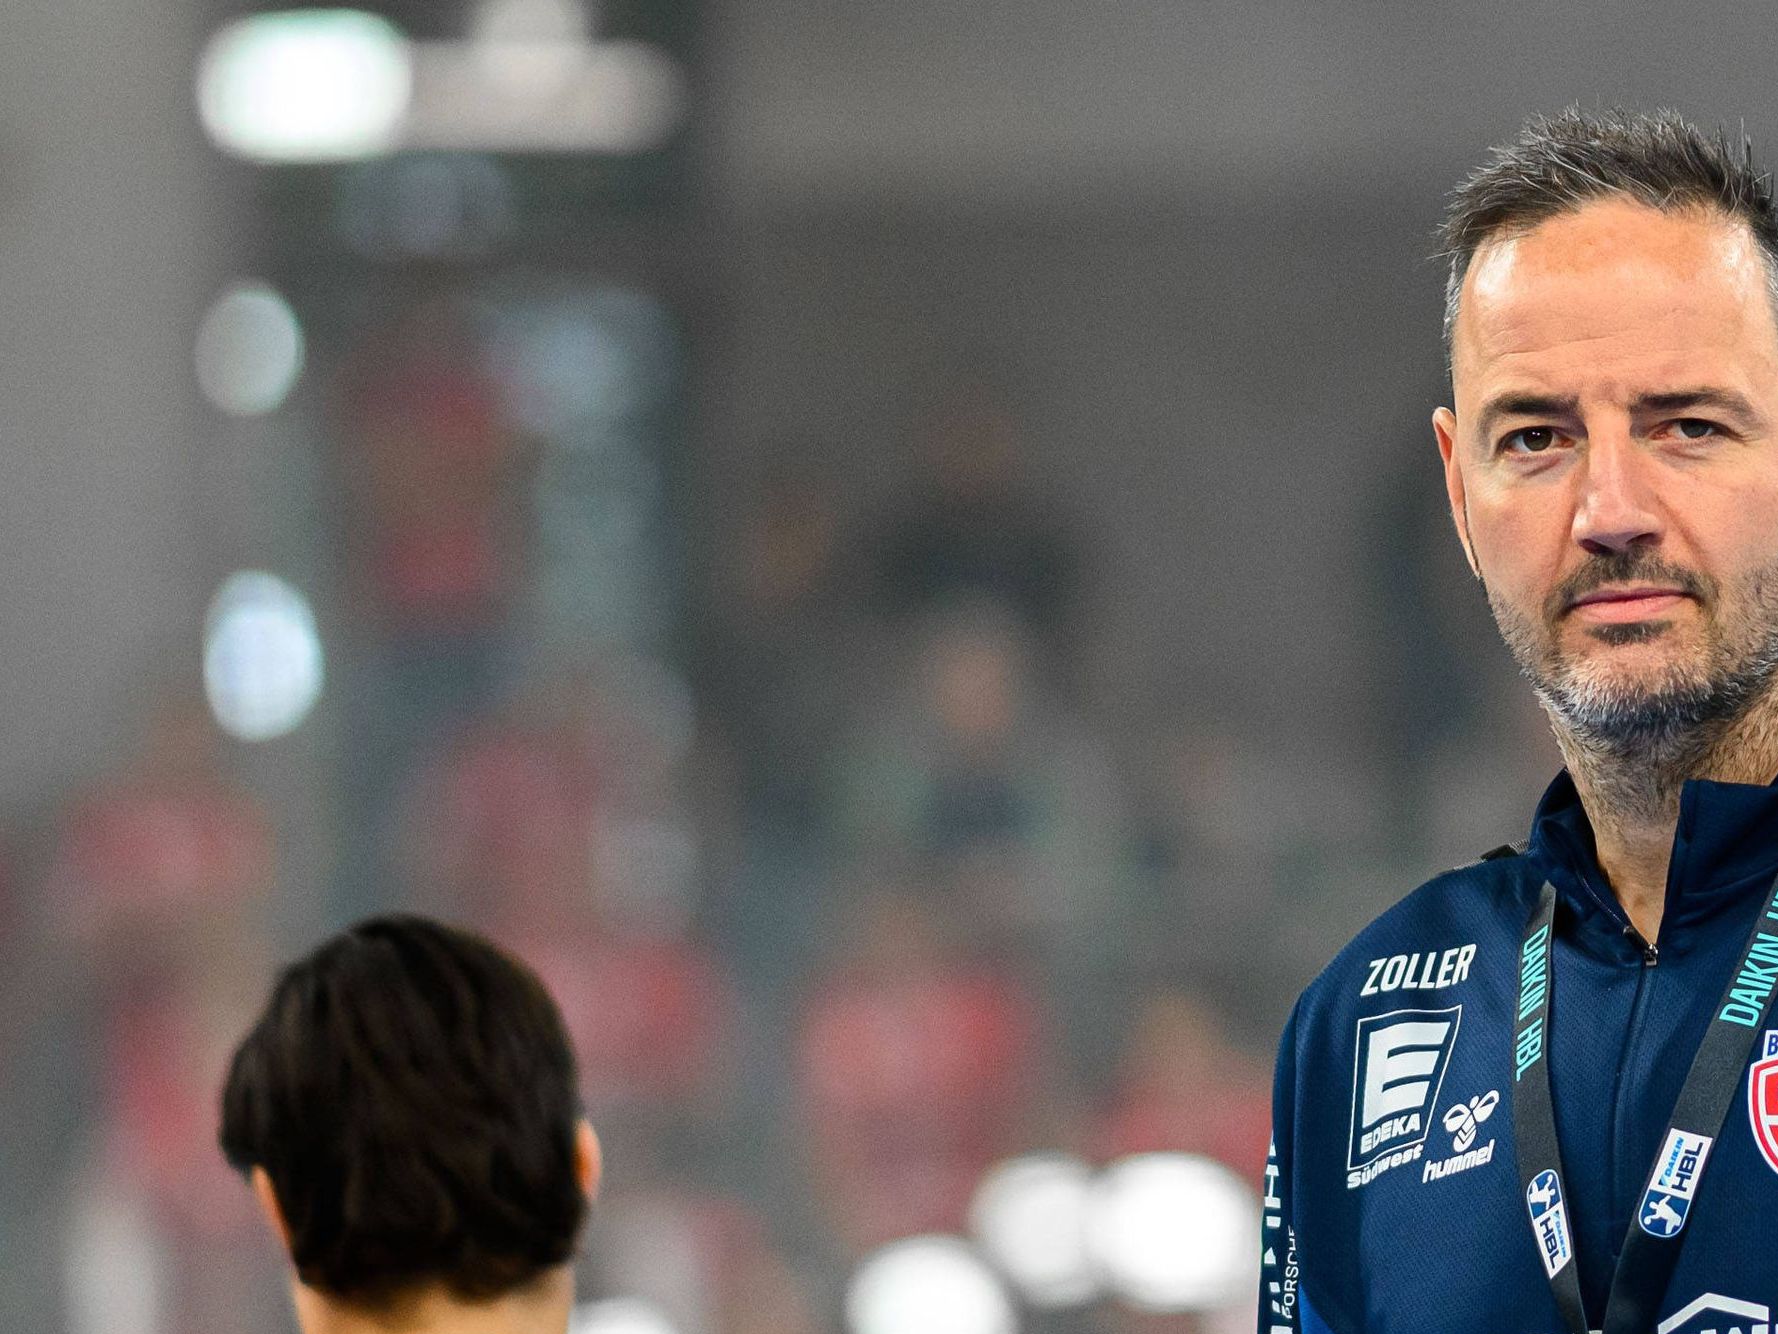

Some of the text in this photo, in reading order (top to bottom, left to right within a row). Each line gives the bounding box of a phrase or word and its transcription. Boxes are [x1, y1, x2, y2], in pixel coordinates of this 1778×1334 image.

[1360, 943, 1477, 997] ZOLLER
[1516, 924, 1549, 1082] DAIKIN HBL
[1360, 1113, 1421, 1155] EDEKA
[1664, 1136, 1684, 1178] DAIKIN
[1347, 1144, 1424, 1189] Südwest
[1422, 1138, 1495, 1184] hummel
[1671, 1141, 1704, 1193] HBL
[1539, 1216, 1559, 1270] HBL
